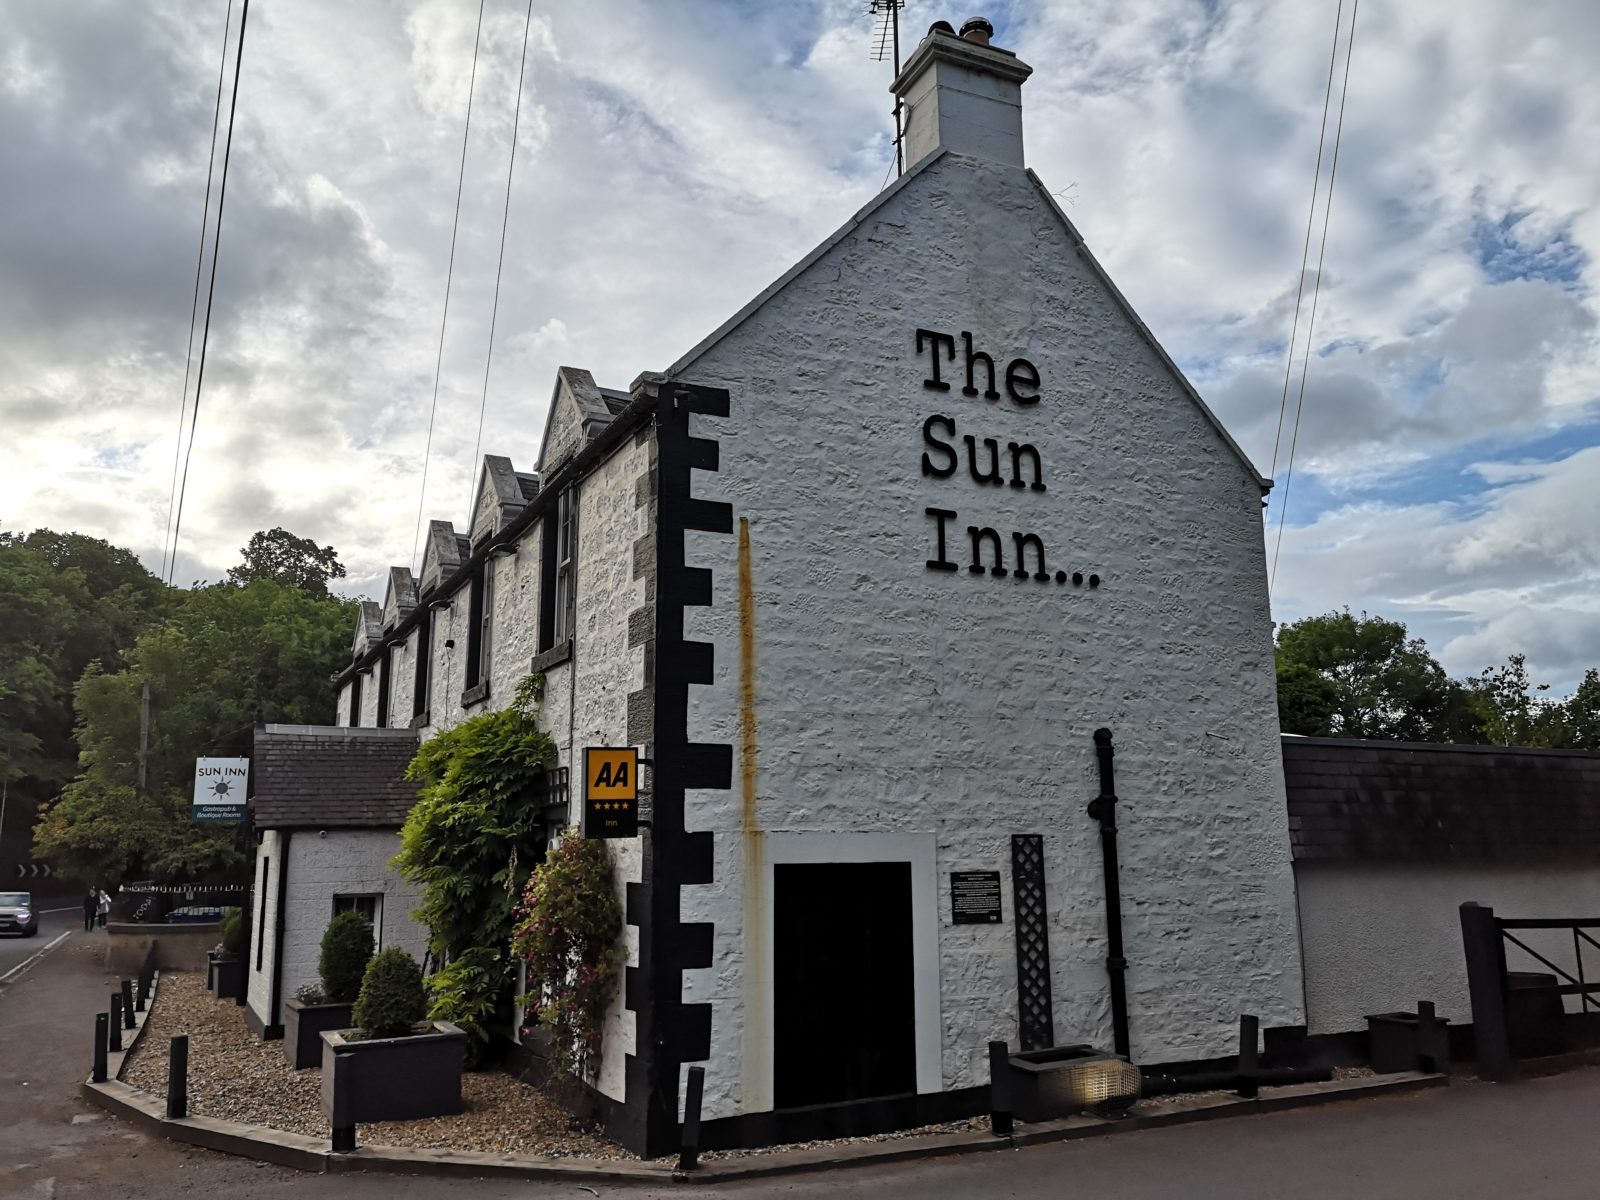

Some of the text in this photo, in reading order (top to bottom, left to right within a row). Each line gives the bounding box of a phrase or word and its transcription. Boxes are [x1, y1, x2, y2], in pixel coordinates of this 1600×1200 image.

[916, 328, 1041, 404] The
[922, 414, 1047, 492] Sun
[198, 768, 246, 776] SUN INN
[593, 762, 628, 787] AA
[605, 818, 618, 827] Inn
